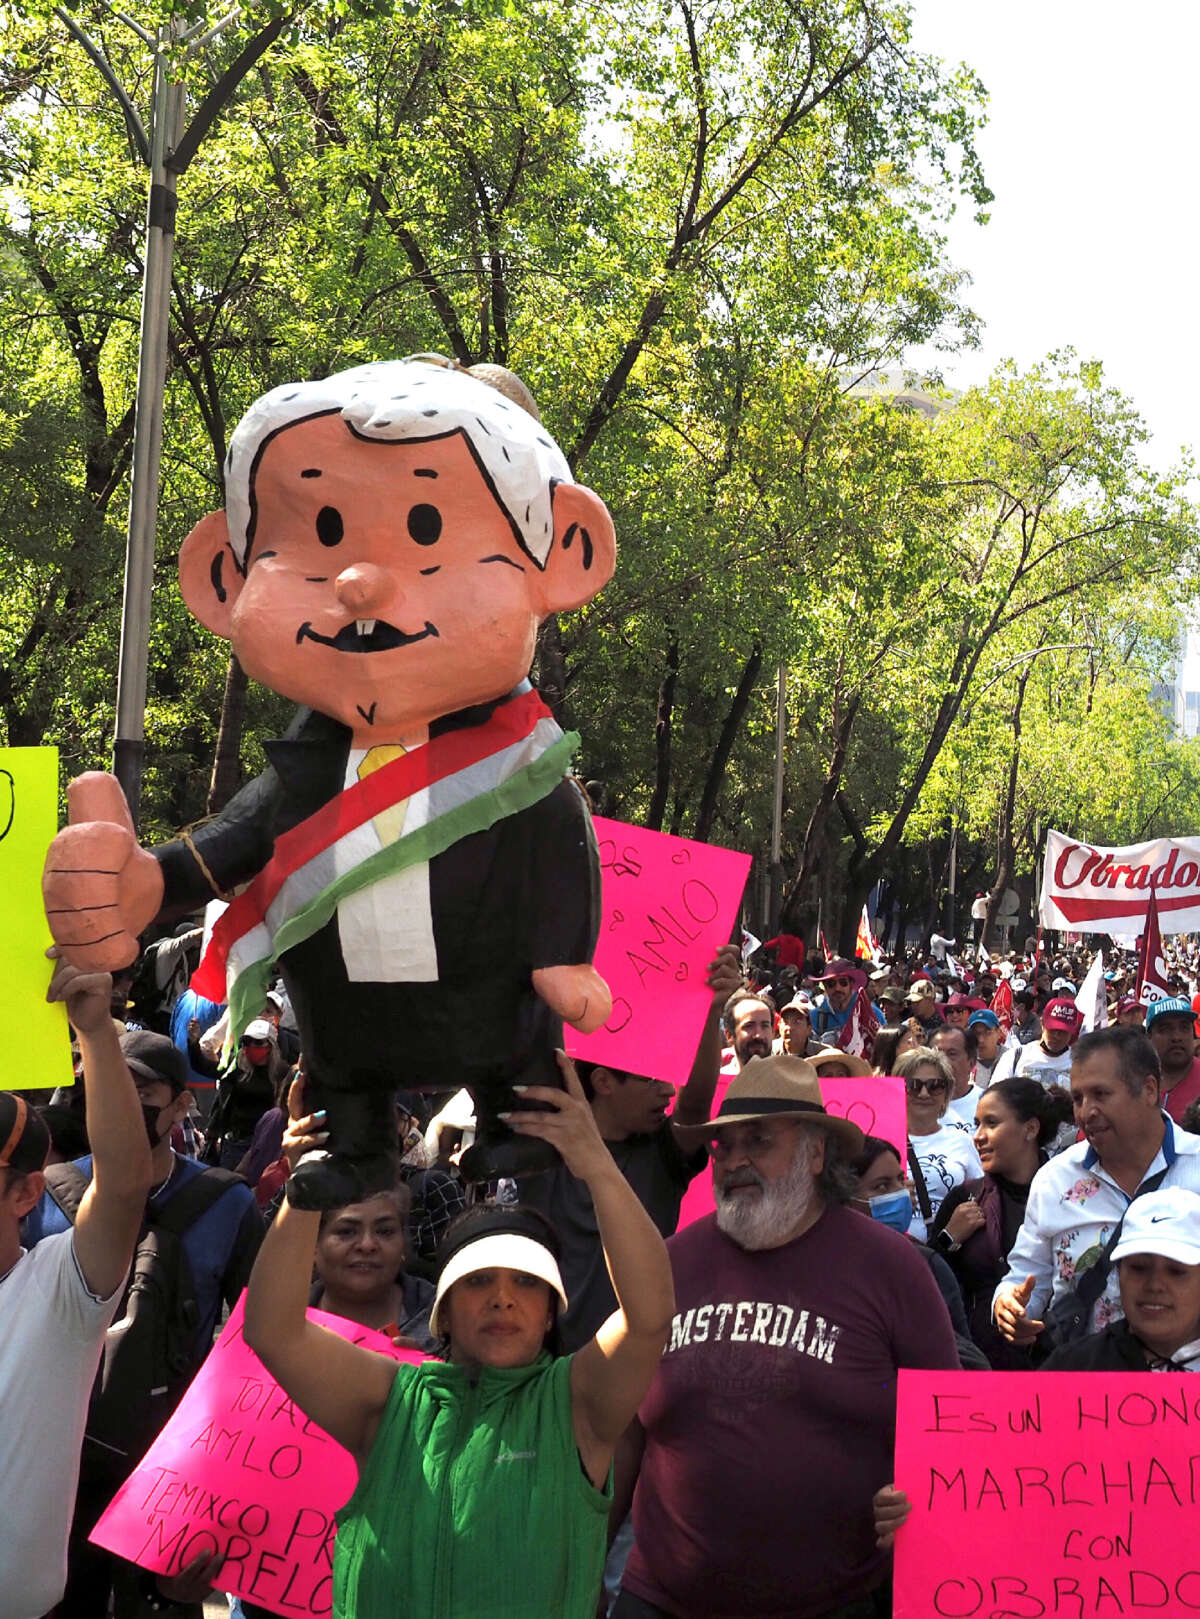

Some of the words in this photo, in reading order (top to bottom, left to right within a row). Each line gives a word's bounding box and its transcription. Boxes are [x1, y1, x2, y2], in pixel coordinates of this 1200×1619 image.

[626, 879, 719, 990] AMLO
[662, 1301, 841, 1365] MSTERDAM
[231, 1376, 328, 1443] TOTAL
[190, 1420, 303, 1480] AMLO
[140, 1467, 270, 1538] TEMIXCO
[1064, 1511, 1132, 1560] CON
